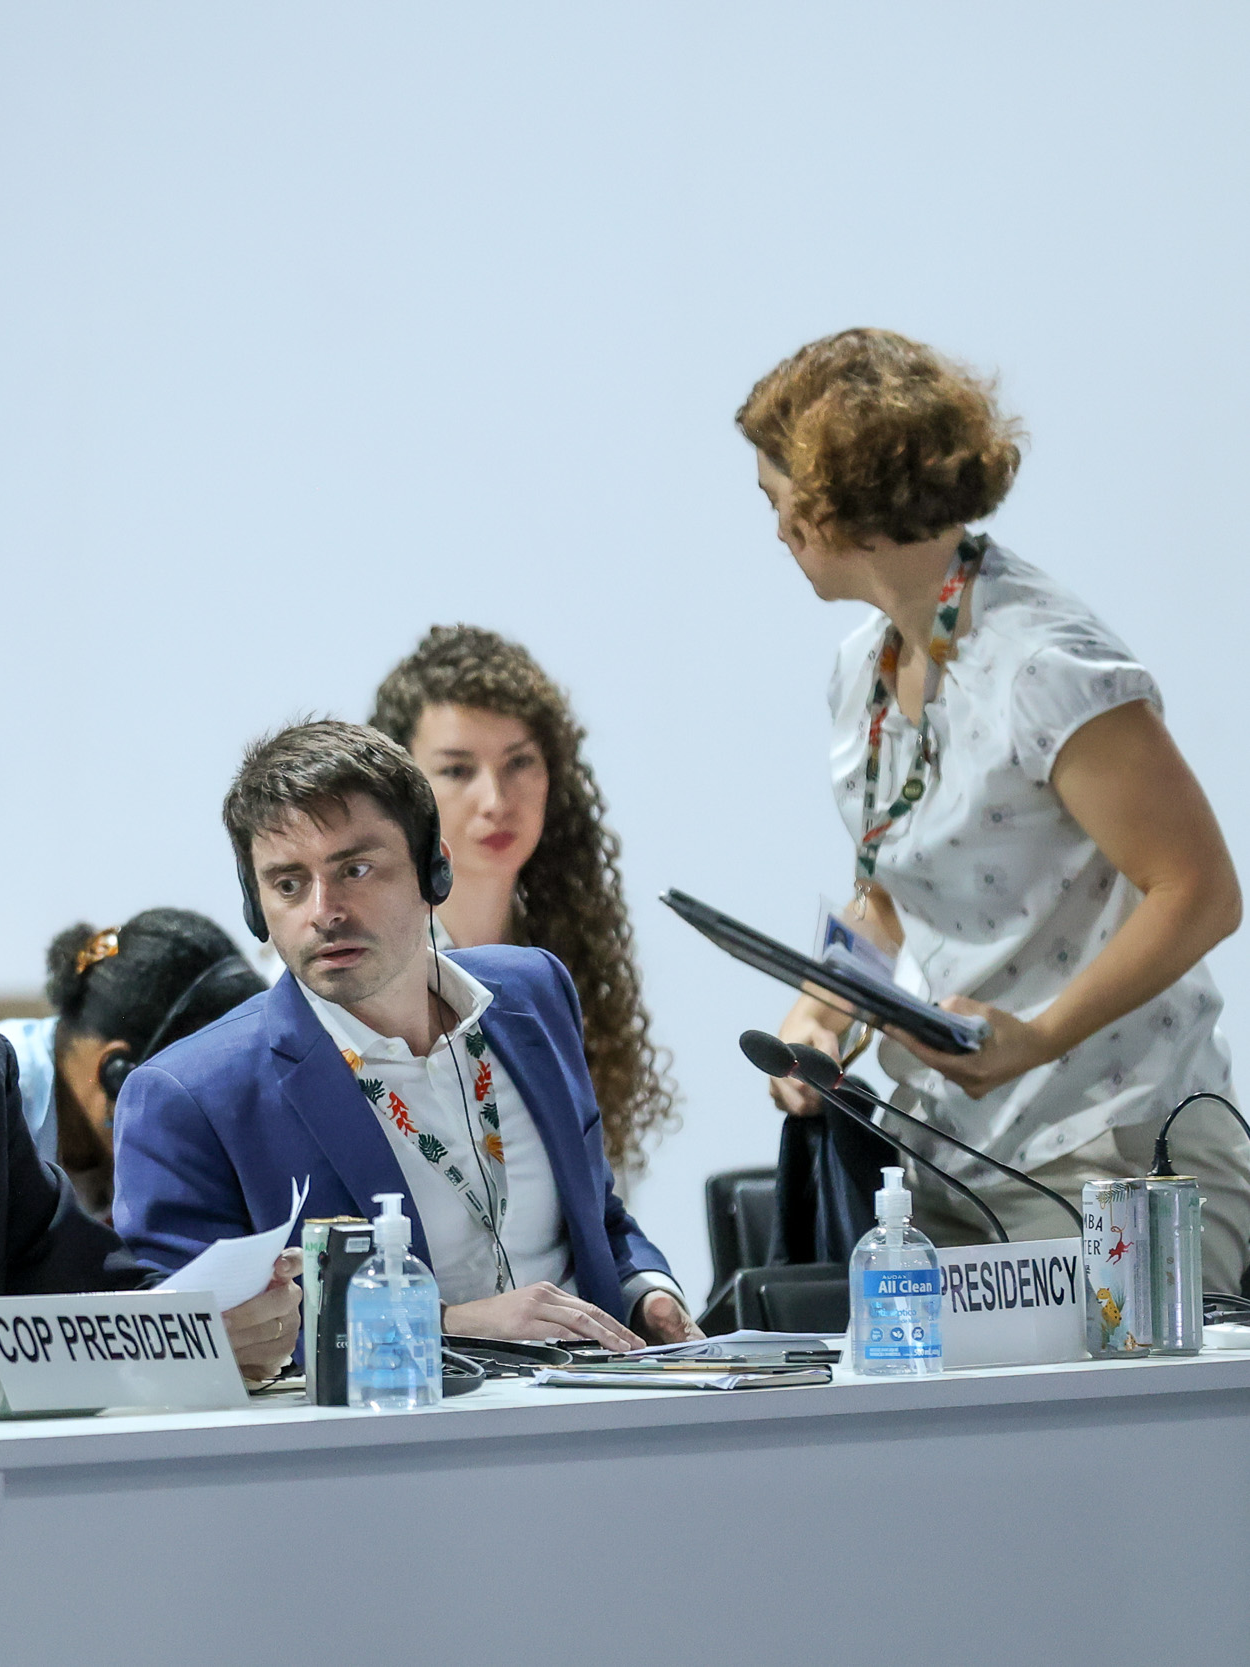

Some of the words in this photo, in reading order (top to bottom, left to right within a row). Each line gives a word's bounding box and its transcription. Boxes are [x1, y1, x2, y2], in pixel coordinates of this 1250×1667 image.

[878, 1280, 897, 1294] All
[899, 1279, 933, 1293] Clean
[57, 1313, 219, 1362] PRESIDENT
